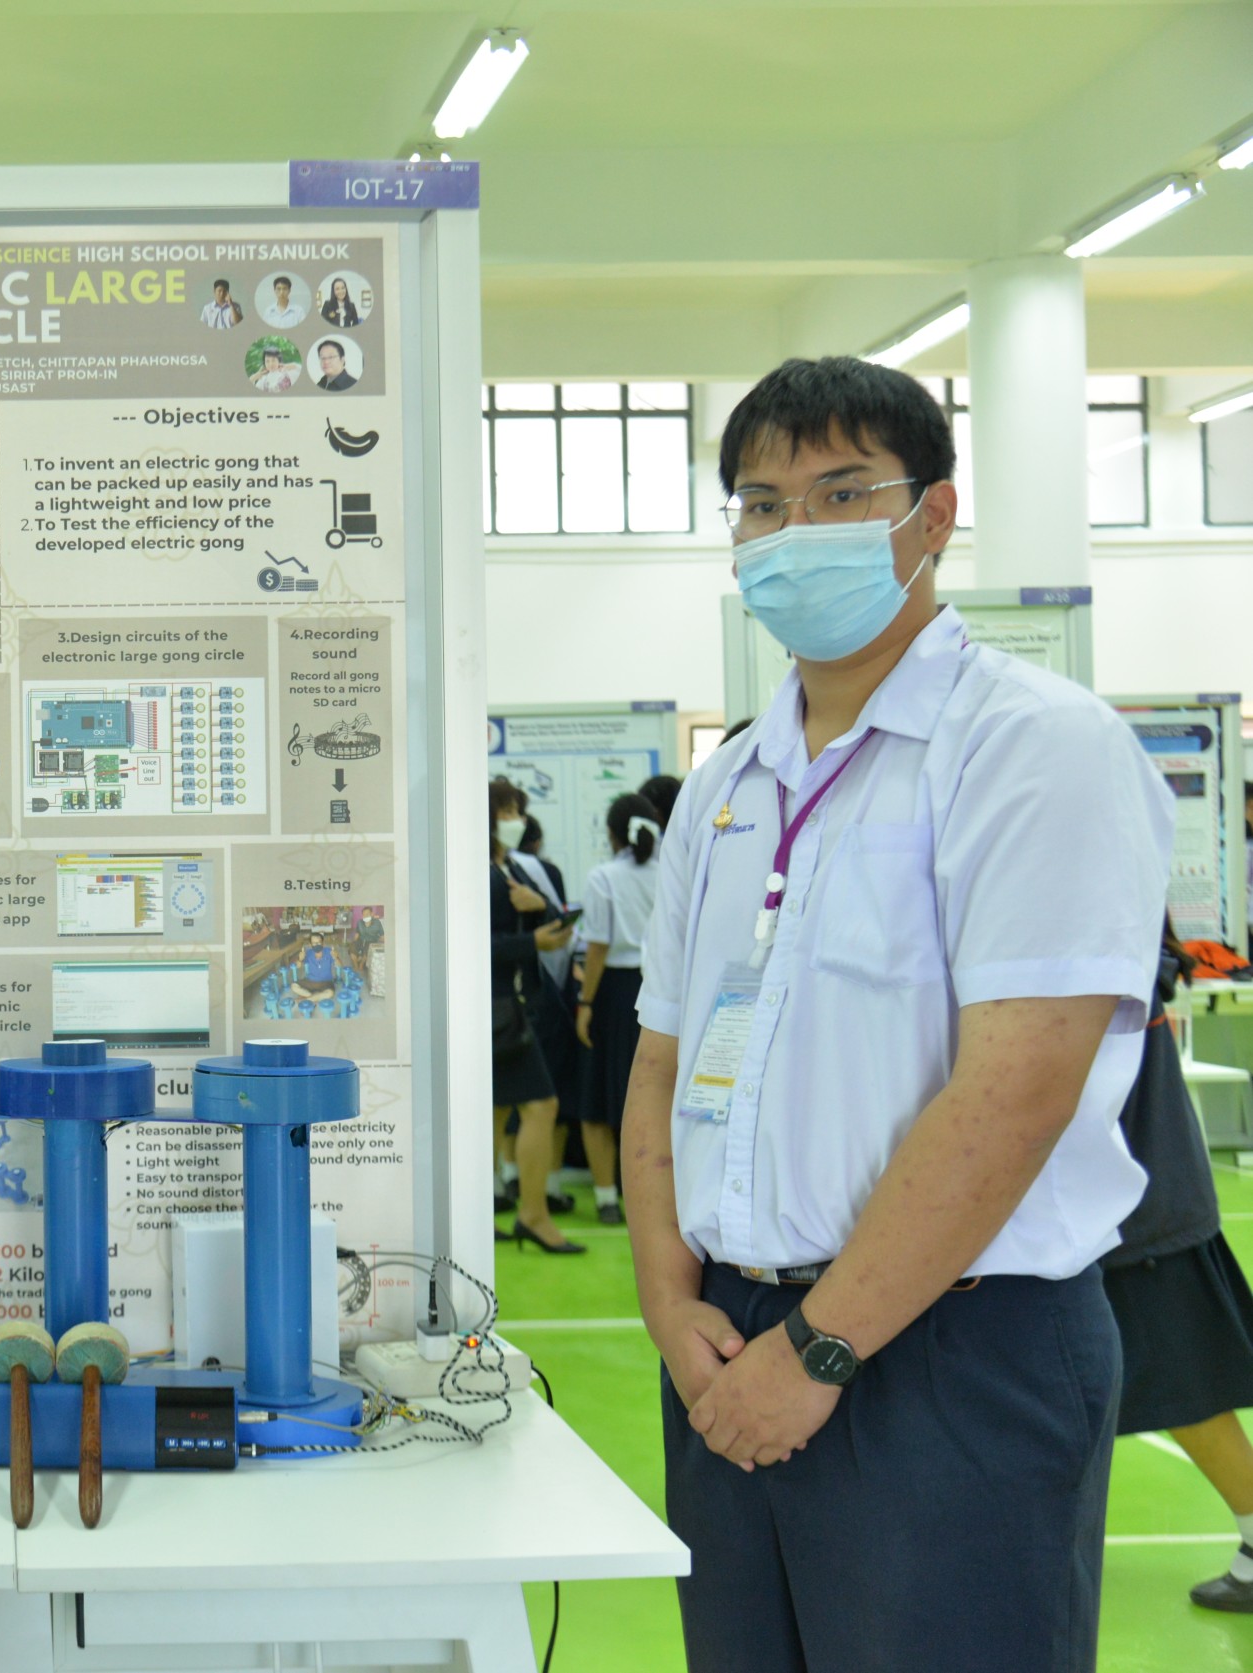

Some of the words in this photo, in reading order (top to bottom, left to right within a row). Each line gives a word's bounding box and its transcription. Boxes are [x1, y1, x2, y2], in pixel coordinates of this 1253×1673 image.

[345, 177, 423, 203] IOT-17
[77, 246, 123, 262] HIGH
[130, 245, 209, 262] SCHOOL
[215, 243, 350, 260] PHITSANULOK
[46, 270, 185, 304] LARGE
[39, 356, 115, 367] CHITTAPAN
[120, 355, 207, 366] PHAHONGSA
[1, 370, 54, 380] SIRIRAT
[58, 369, 117, 380] PROM-IN
[144, 408, 259, 426] Objectives
[34, 458, 54, 470] To
[61, 457, 114, 469] invent
[120, 460, 140, 469] an
[146, 456, 209, 468] electric
[215, 458, 258, 471] gong
[264, 455, 299, 467] that
[35, 501, 43, 510] a
[50, 498, 149, 513] lightweight
[155, 497, 186, 508] and
[193, 497, 222, 508] low
[229, 498, 270, 510] price
[35, 537, 124, 552] developed
[131, 537, 194, 548] electric
[200, 538, 243, 551] gong
[58, 631, 120, 643] 3.Design
[126, 630, 180, 641] circuits
[185, 630, 199, 640] of
[203, 630, 227, 640] the
[290, 628, 378, 641] 4.Recording
[312, 648, 356, 658] sound
[313, 698, 328, 706] SD
[332, 698, 356, 706] card
[15, 874, 36, 884] for
[284, 878, 350, 892] 8.Testing
[3, 916, 30, 926] app
[137, 1126, 211, 1136] Reasonable
[330, 1122, 395, 1134] electricity
[337, 1138, 365, 1150] only
[369, 1140, 393, 1148] one
[137, 1157, 169, 1169] Light
[173, 1156, 219, 1168] weight
[347, 1153, 403, 1166] dynamic
[137, 1173, 166, 1184] Easy
[169, 1173, 183, 1183] to
[119, 1288, 152, 1299] gong
